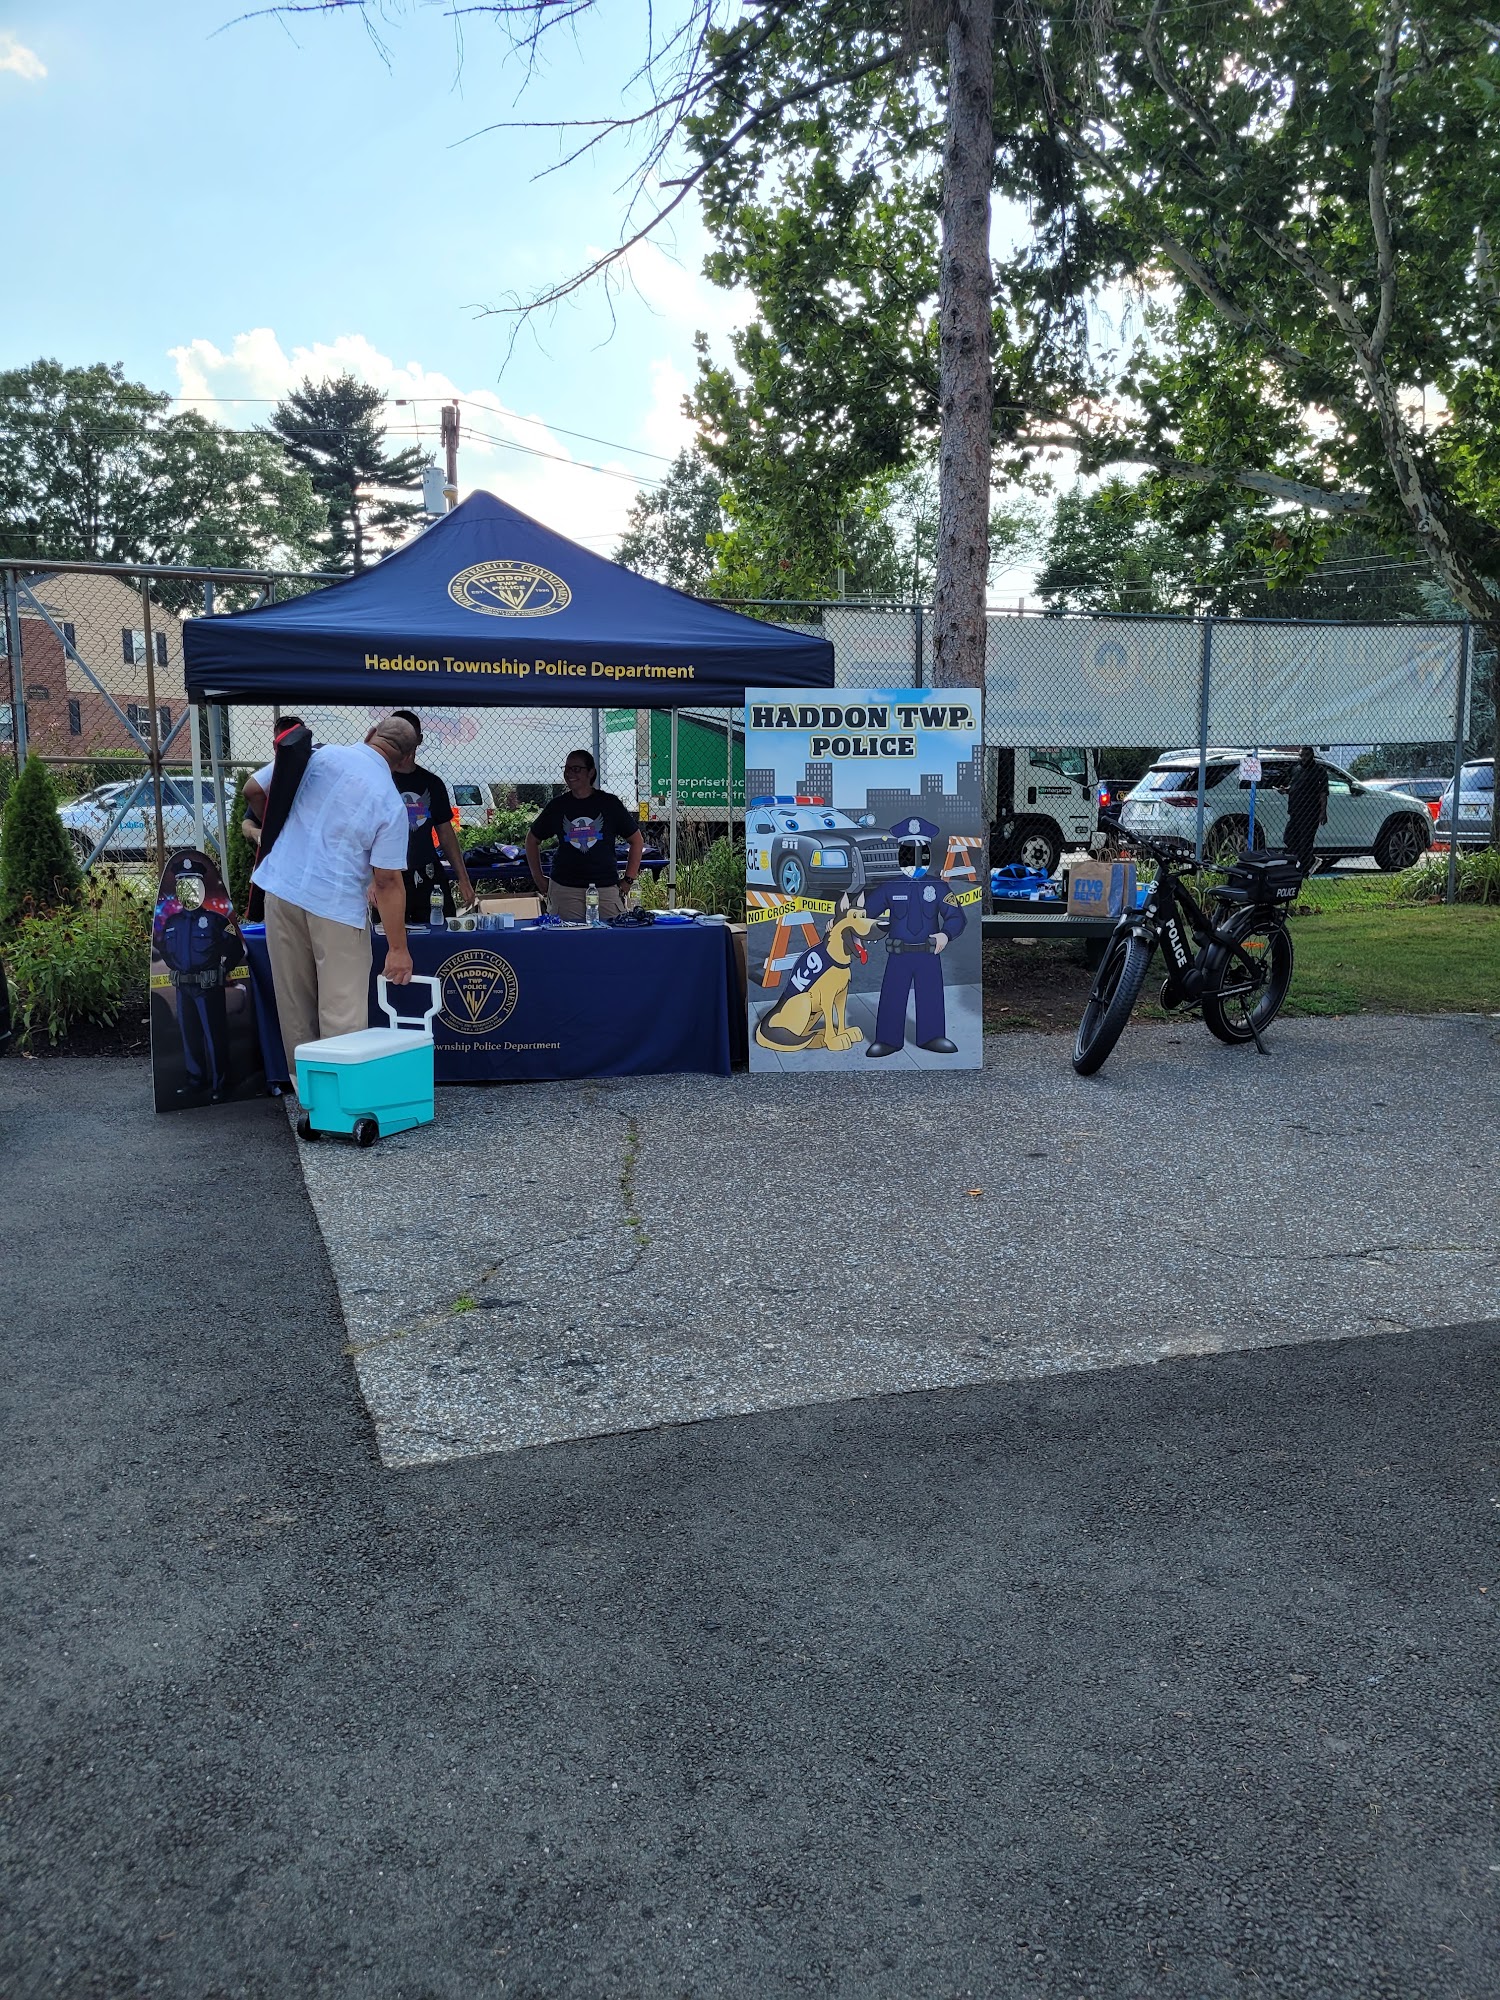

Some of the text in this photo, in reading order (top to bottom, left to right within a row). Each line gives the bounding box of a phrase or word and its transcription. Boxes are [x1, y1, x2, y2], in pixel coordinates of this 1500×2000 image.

[459, 562, 514, 584] INTEGRITY
[521, 564, 568, 605] COMMITMENT
[480, 575, 532, 584] HADDON
[499, 590, 525, 606] NJ
[364, 653, 695, 681] Haddon Township Police Department
[751, 705, 974, 729] HADDON TWP.
[811, 736, 915, 757] POLICE
[781, 840, 798, 850] 911
[1073, 878, 1104, 893] five
[1276, 887, 1297, 898] POLICE
[802, 899, 832, 912] POLICE
[959, 893, 970, 905] DO
[748, 901, 796, 923] NOT CROSS
[1165, 918, 1188, 969] POLICE
[456, 969, 495, 980] HADDON
[790, 951, 823, 992] K-9
[440, 952, 487, 978] INTEGRITY
[489, 955, 517, 1014] COMMITMENT
[465, 990, 485, 1014] NJ
[434, 1039, 560, 1053] wnship Police Department
